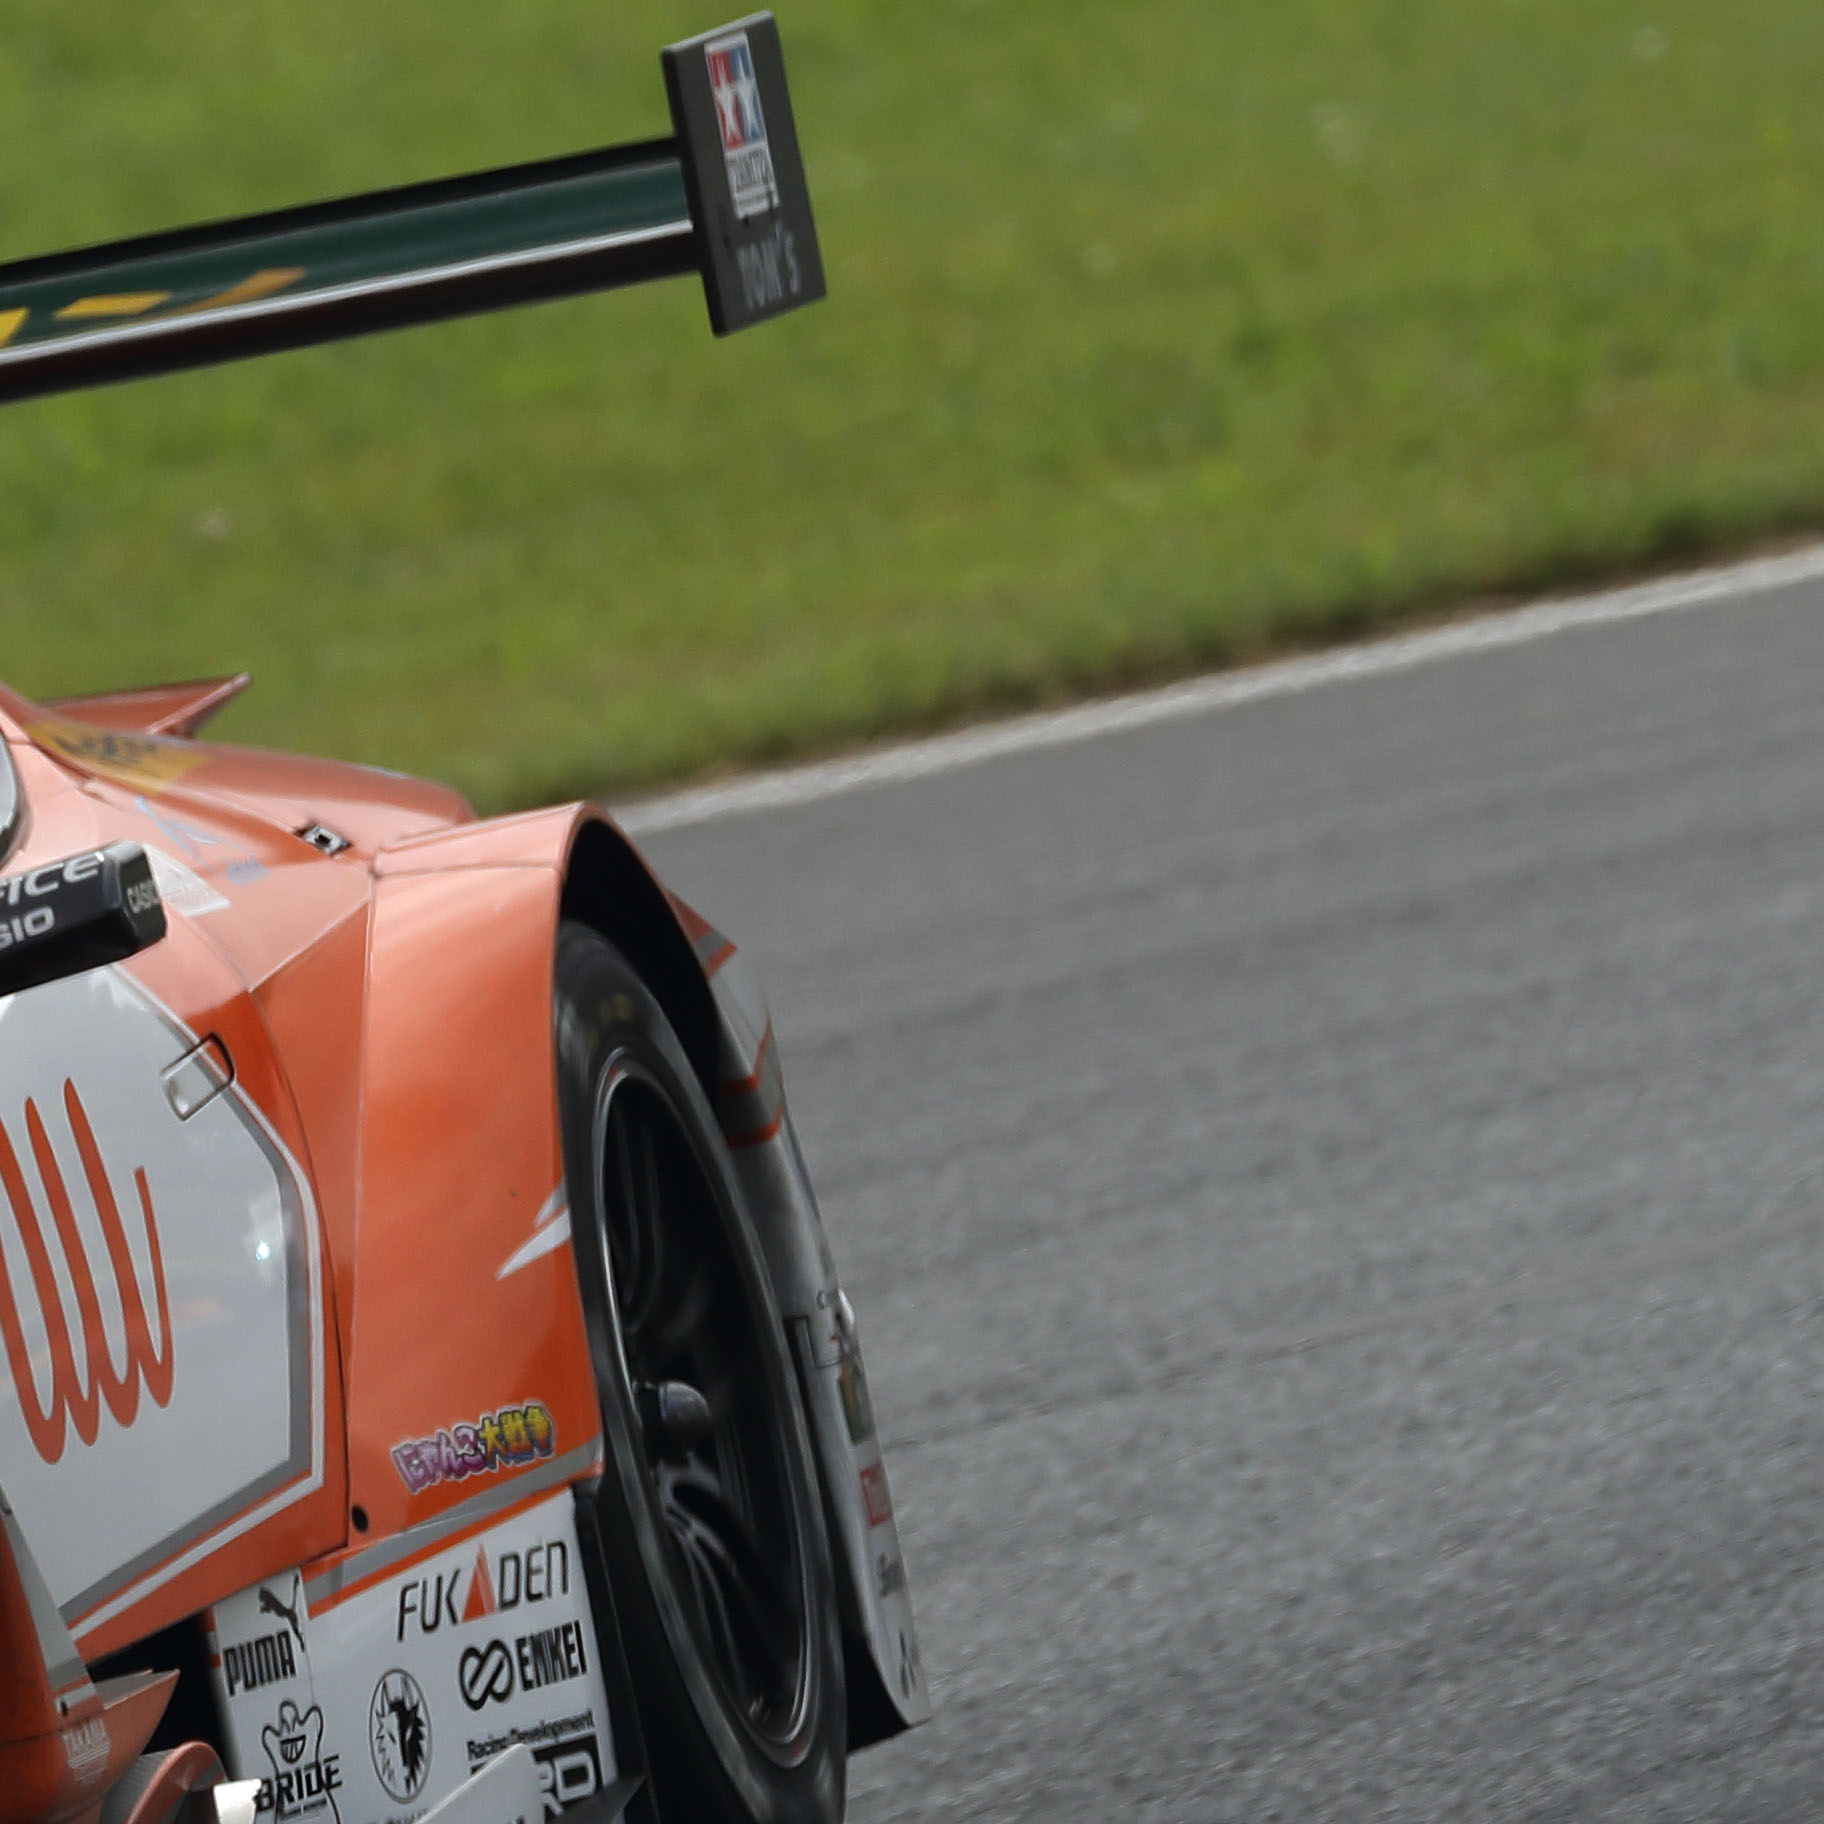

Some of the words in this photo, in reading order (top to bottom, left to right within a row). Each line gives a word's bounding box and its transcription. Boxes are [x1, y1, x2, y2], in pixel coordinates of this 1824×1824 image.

[222, 1629, 297, 1697] PUMA
[516, 1620, 588, 1692] ENKEI
[253, 1754, 344, 1812] BRIDE
